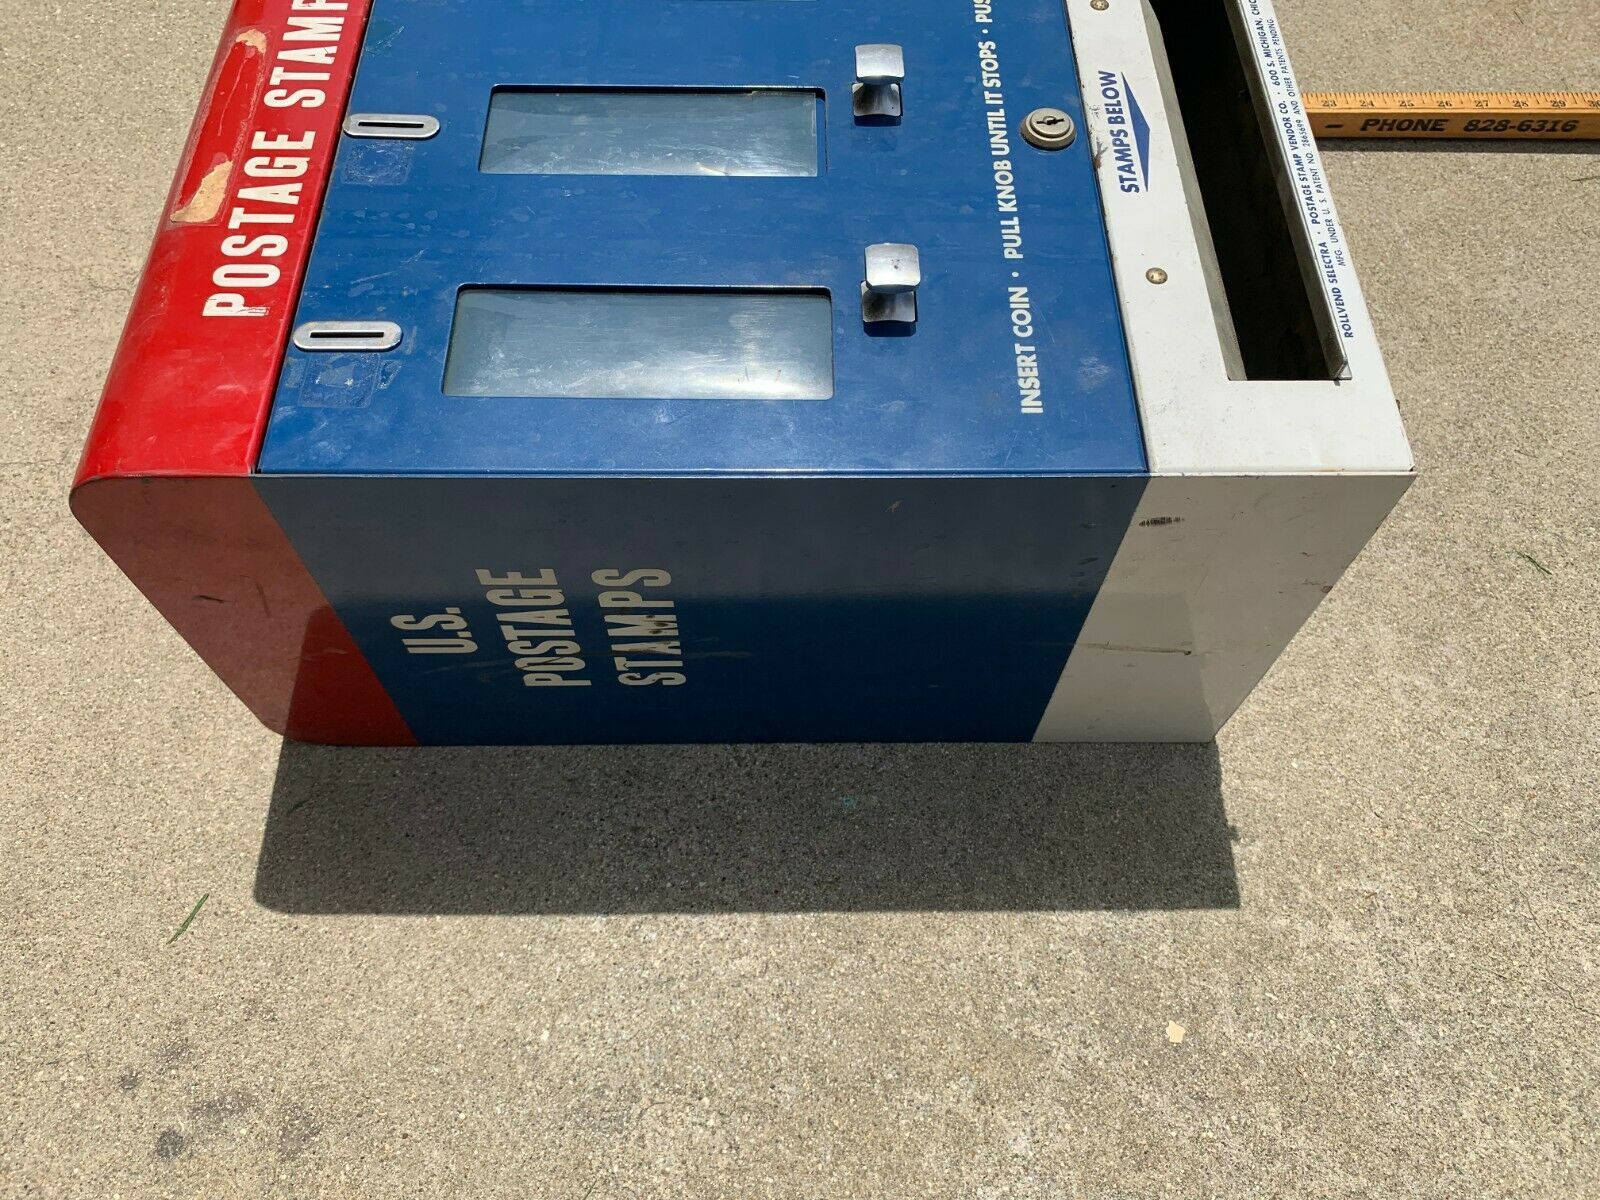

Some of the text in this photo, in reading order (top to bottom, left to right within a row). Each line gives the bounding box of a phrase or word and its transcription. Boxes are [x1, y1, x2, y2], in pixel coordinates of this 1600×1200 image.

[1254, 17, 1273, 58] MICHIGAN,
[978, 41, 1001, 88] STOPS
[1269, 70, 1281, 86] 600
[1274, 48, 1289, 74] PATENTS
[984, 90, 1003, 105] IT
[1278, 100, 1289, 114] CO.
[1283, 77, 1296, 97] OTHER
[1399, 100, 1415, 108] 25
[1437, 100, 1452, 108] 26
[1474, 100, 1490, 108] 27
[1512, 100, 1529, 108] 28
[1550, 100, 1566, 108] 29
[1290, 101, 1302, 115] AND
[1360, 118, 1580, 133] PHONE 828-6316
[986, 109, 1012, 156] UNTIL
[1098, 70, 1139, 193] STAMPS BELOW
[1282, 117, 1300, 151] VENDOR
[993, 160, 1018, 211] KNOB
[1293, 153, 1308, 181] STAMP
[1309, 167, 1325, 193] PATENT
[202, 131, 316, 316] POSTAGE
[1301, 184, 1321, 224] POSTAGE
[1000, 216, 1023, 259] PULL
[1325, 218, 1339, 243] UNDER
[1318, 242, 1338, 283] SELECTRA
[1008, 286, 1033, 337] COIN
[1331, 287, 1353, 338] ROLLVEND
[1014, 343, 1043, 414] INSERT
[390, 607, 478, 654] U.S.
[475, 568, 592, 687] POSTAGE
[590, 568, 687, 686] STAMPS
